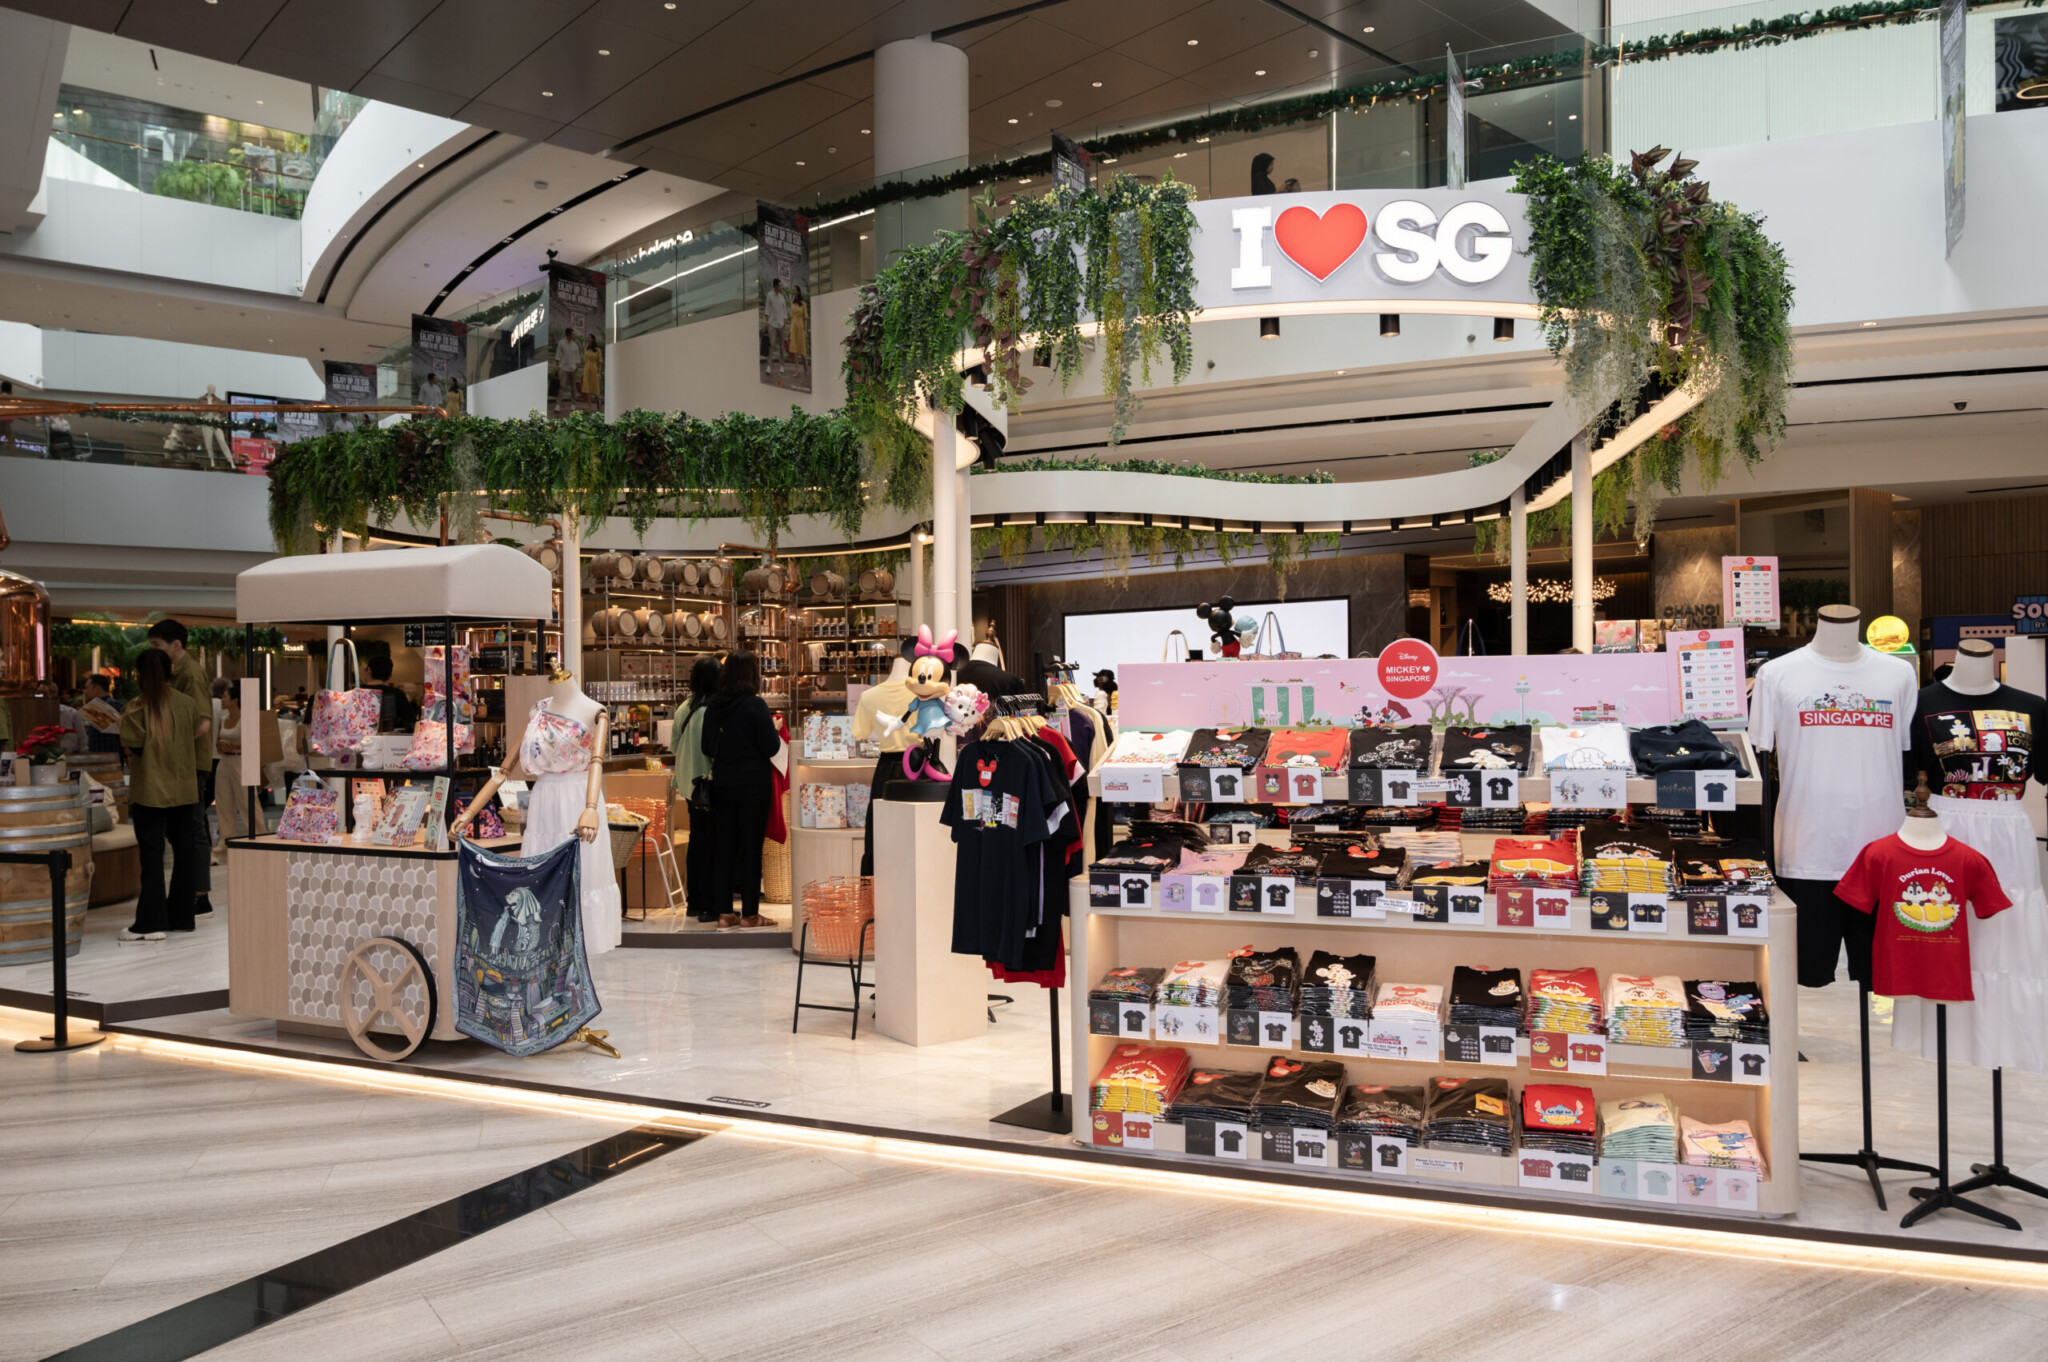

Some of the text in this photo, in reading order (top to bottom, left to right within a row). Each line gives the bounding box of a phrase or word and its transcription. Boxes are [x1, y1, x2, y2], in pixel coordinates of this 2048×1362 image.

[1231, 200, 1513, 289] I SG
[2035, 621, 2046, 629] BY
[283, 644, 304, 652] Toast
[1397, 652, 1419, 662] Disney
[1385, 666, 1421, 674] MICKEY
[1385, 675, 1431, 683] SINGAPORE
[1594, 841, 1662, 854] Durian Lover
[1899, 867, 1954, 884] Durian Lover
[1115, 1060, 1167, 1076] Durian Lover
